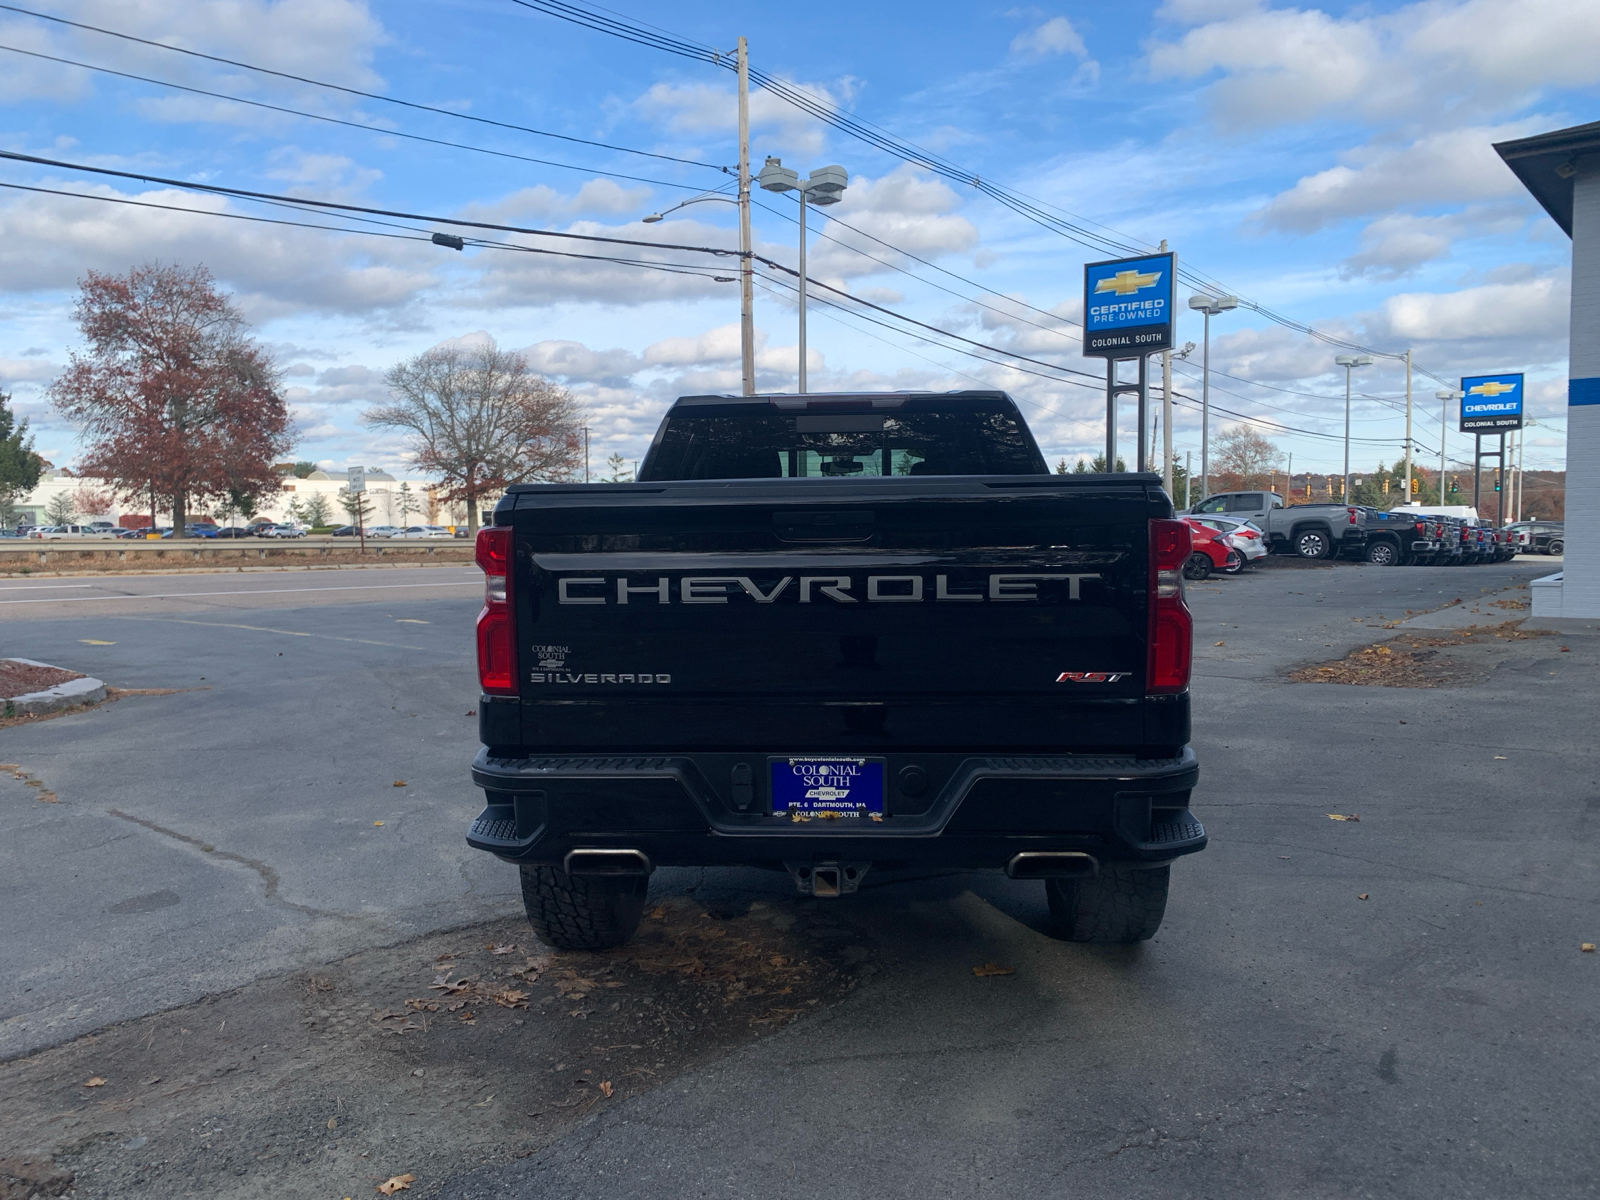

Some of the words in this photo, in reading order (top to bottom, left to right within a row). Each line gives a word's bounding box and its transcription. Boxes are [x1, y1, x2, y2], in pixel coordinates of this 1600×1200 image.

[1090, 299, 1164, 315] CERTIFIED
[1094, 309, 1161, 323] PRE-OWNED
[1092, 336, 1131, 348] COLONIAL
[1135, 333, 1162, 343] SOUTH
[1465, 402, 1518, 412] CHEVROLET
[558, 573, 1102, 604] CHEVROLET
[531, 645, 571, 653] COLONIAL
[537, 652, 565, 660] SOUTH
[530, 673, 672, 684] SILVERADO
[1055, 672, 1133, 683] RST
[793, 765, 861, 776] COLONIAL
[803, 776, 851, 787] SOUTH
